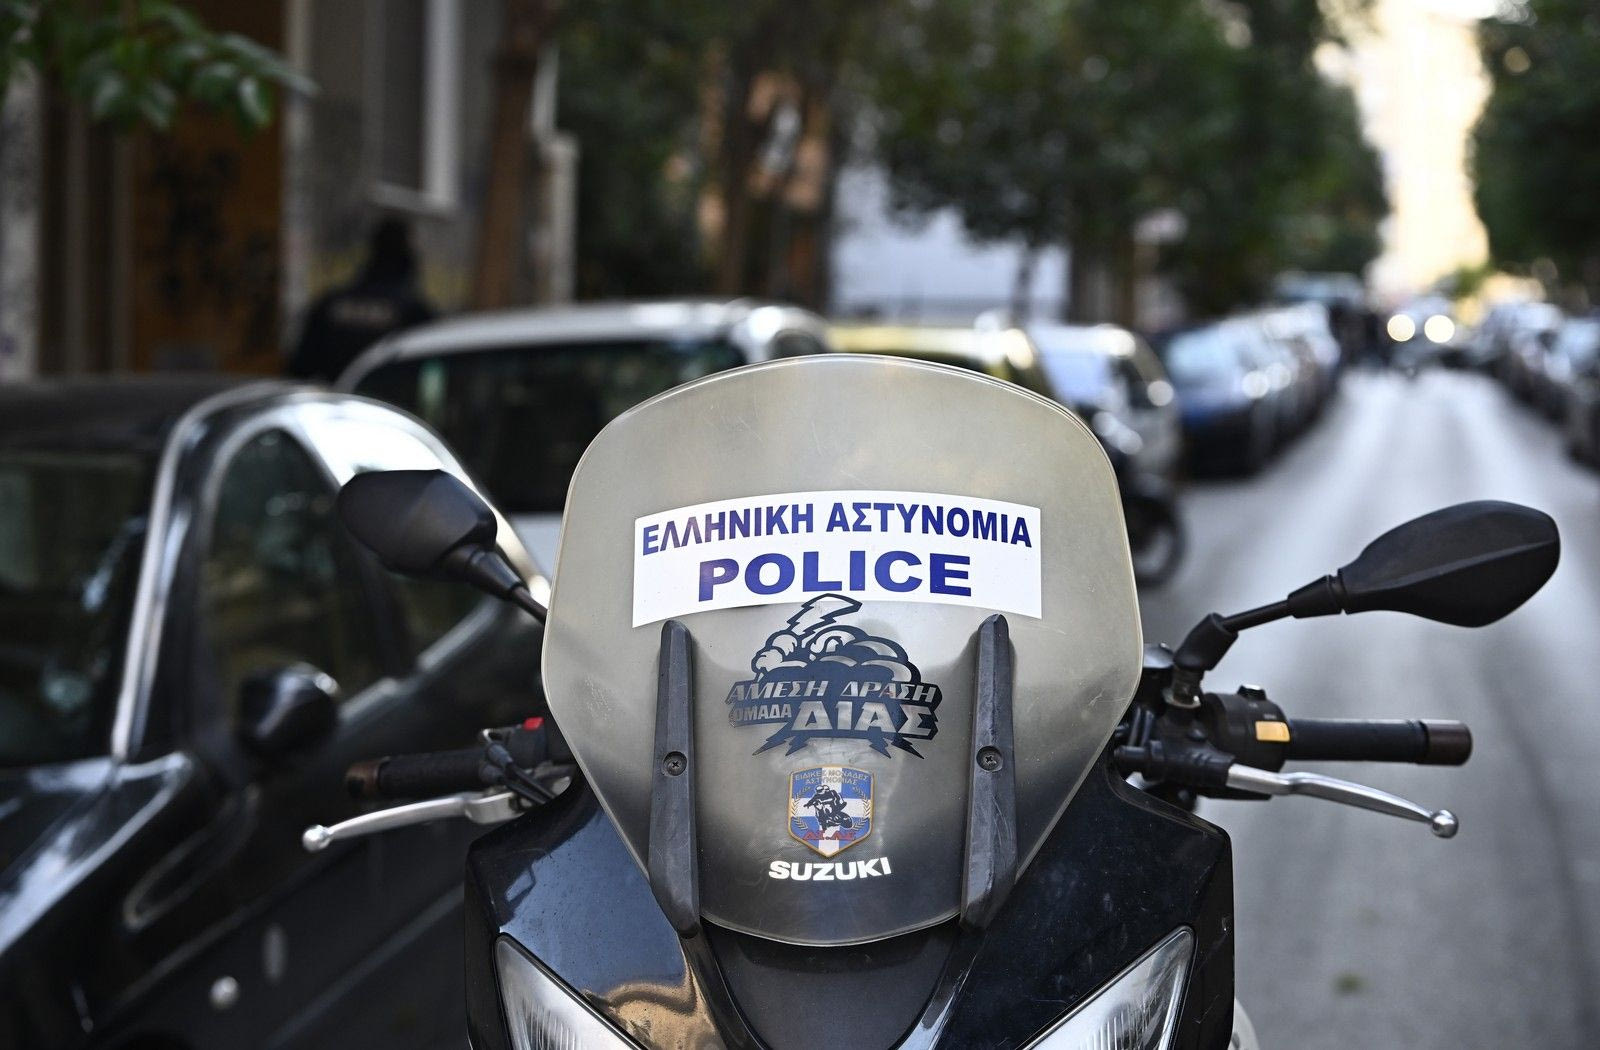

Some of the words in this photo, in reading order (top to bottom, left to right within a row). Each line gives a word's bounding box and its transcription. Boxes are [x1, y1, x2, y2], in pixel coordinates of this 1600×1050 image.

[642, 504, 814, 555] ΕΛΛΗΝΙΚΗ
[826, 502, 1032, 547] ΑΣΤΥΝΟΜΙΑ
[698, 550, 972, 602] POLICE
[728, 680, 828, 701] ΑΜΕΣΗ
[840, 681, 936, 702] ΔΡΑΣΗ
[734, 703, 792, 721] ΟΜΑΔΑ
[791, 700, 936, 735] ΔΙΑΣ
[768, 856, 892, 881] SUZUKI
